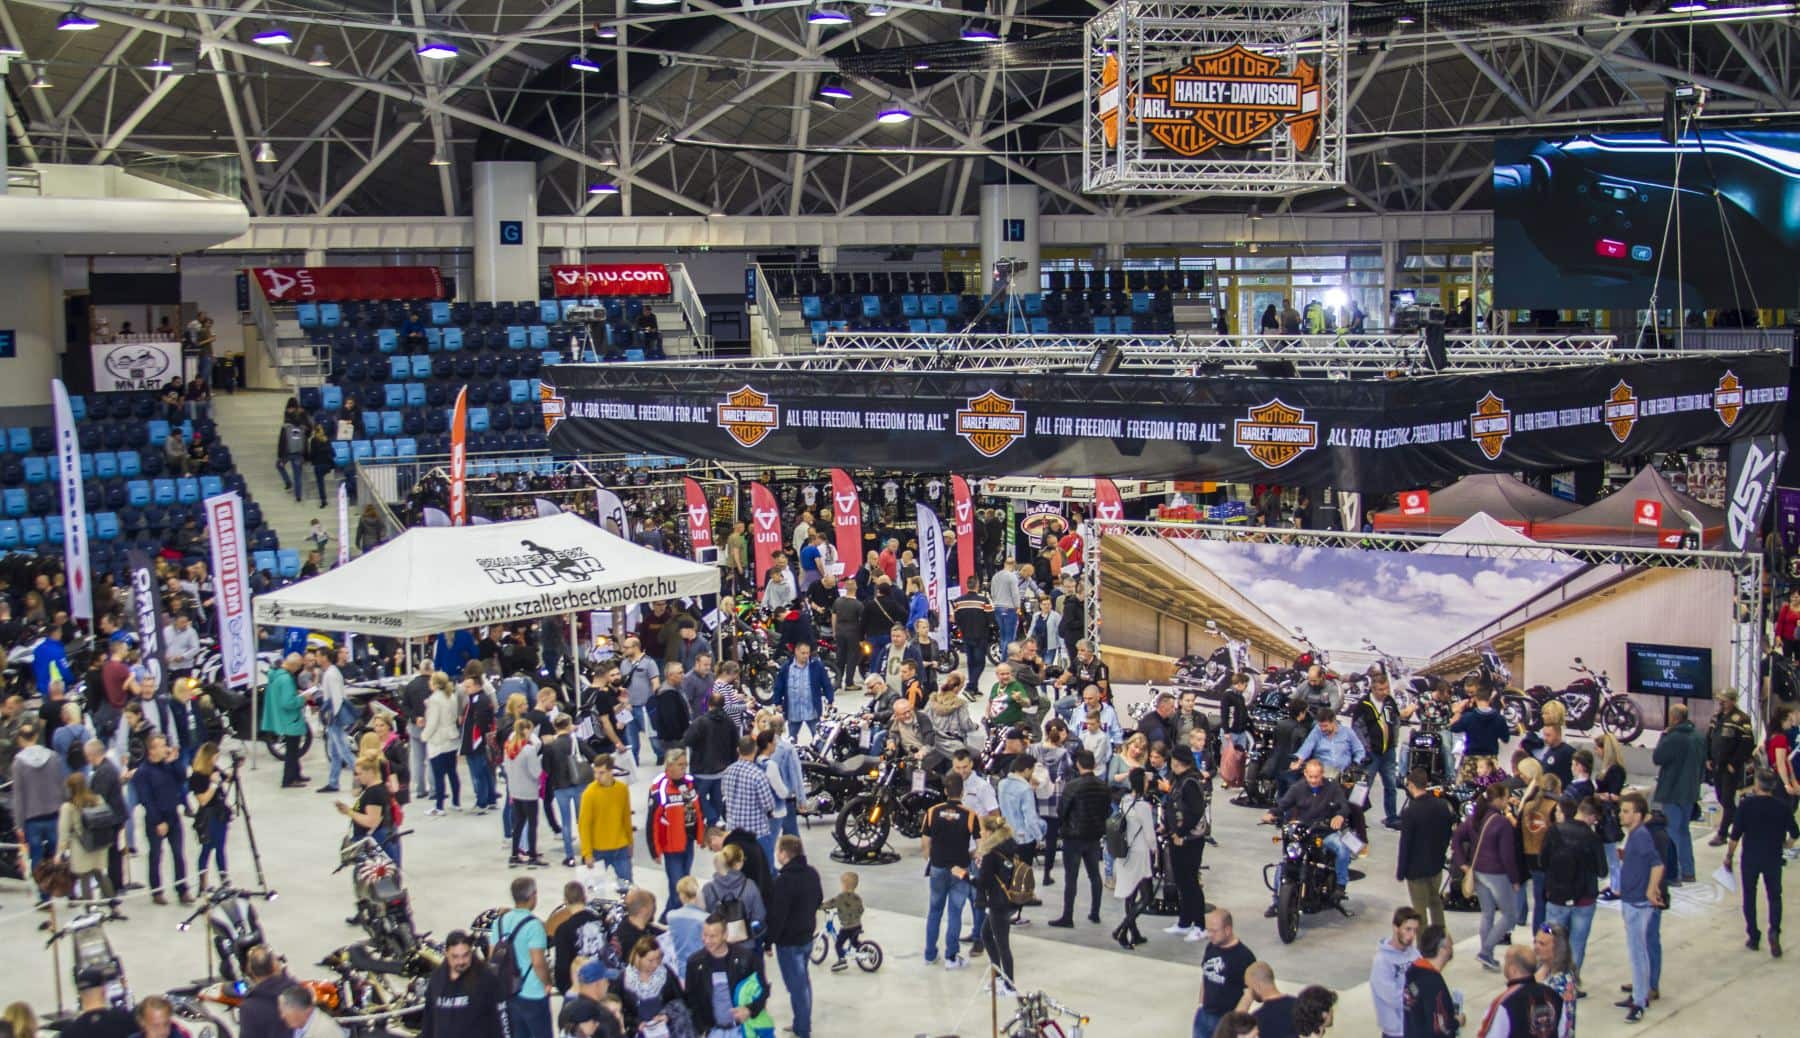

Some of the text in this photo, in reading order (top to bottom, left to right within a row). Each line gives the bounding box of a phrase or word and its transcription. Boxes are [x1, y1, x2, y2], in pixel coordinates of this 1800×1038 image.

[1204, 53, 1270, 76] MOTOR
[1174, 80, 1297, 106] HARLEY-DAVIDSON
[1203, 111, 1268, 140] CYCLES
[1159, 124, 1209, 152] CYCLE
[504, 225, 519, 241] G
[138, 379, 162, 390] ART
[734, 391, 762, 406] MOTOR
[975, 401, 1007, 413] MOTOR
[638, 405, 674, 422] FREEDOM
[675, 406, 691, 423] FOR
[787, 409, 801, 427] ALL
[802, 410, 818, 427] FOR
[865, 412, 905, 430] FREEDOM
[907, 412, 924, 430] FOR
[1257, 409, 1295, 424] MOTOR
[962, 416, 1020, 431] HARLEY-DAVIDSON
[1035, 416, 1052, 435] ALL
[1054, 417, 1073, 436] FOR
[1075, 418, 1124, 438] FREEDOM.
[1126, 420, 1174, 440] FREEDOM
[1176, 421, 1196, 441] FOR
[733, 426, 764, 441] CYCLES
[1241, 426, 1310, 443] HARLEY-DAVIDSON
[1327, 428, 1347, 447] ALL
[1350, 428, 1371, 448] FOR
[1440, 422, 1452, 441] FOR
[975, 435, 1008, 452] CYCLES
[1255, 447, 1297, 465] CYCLES
[1727, 443, 1775, 550] 4SR
[464, 576, 678, 623] www.szallerbeckmotor.hu
[1662, 668, 1678, 681] VS.
